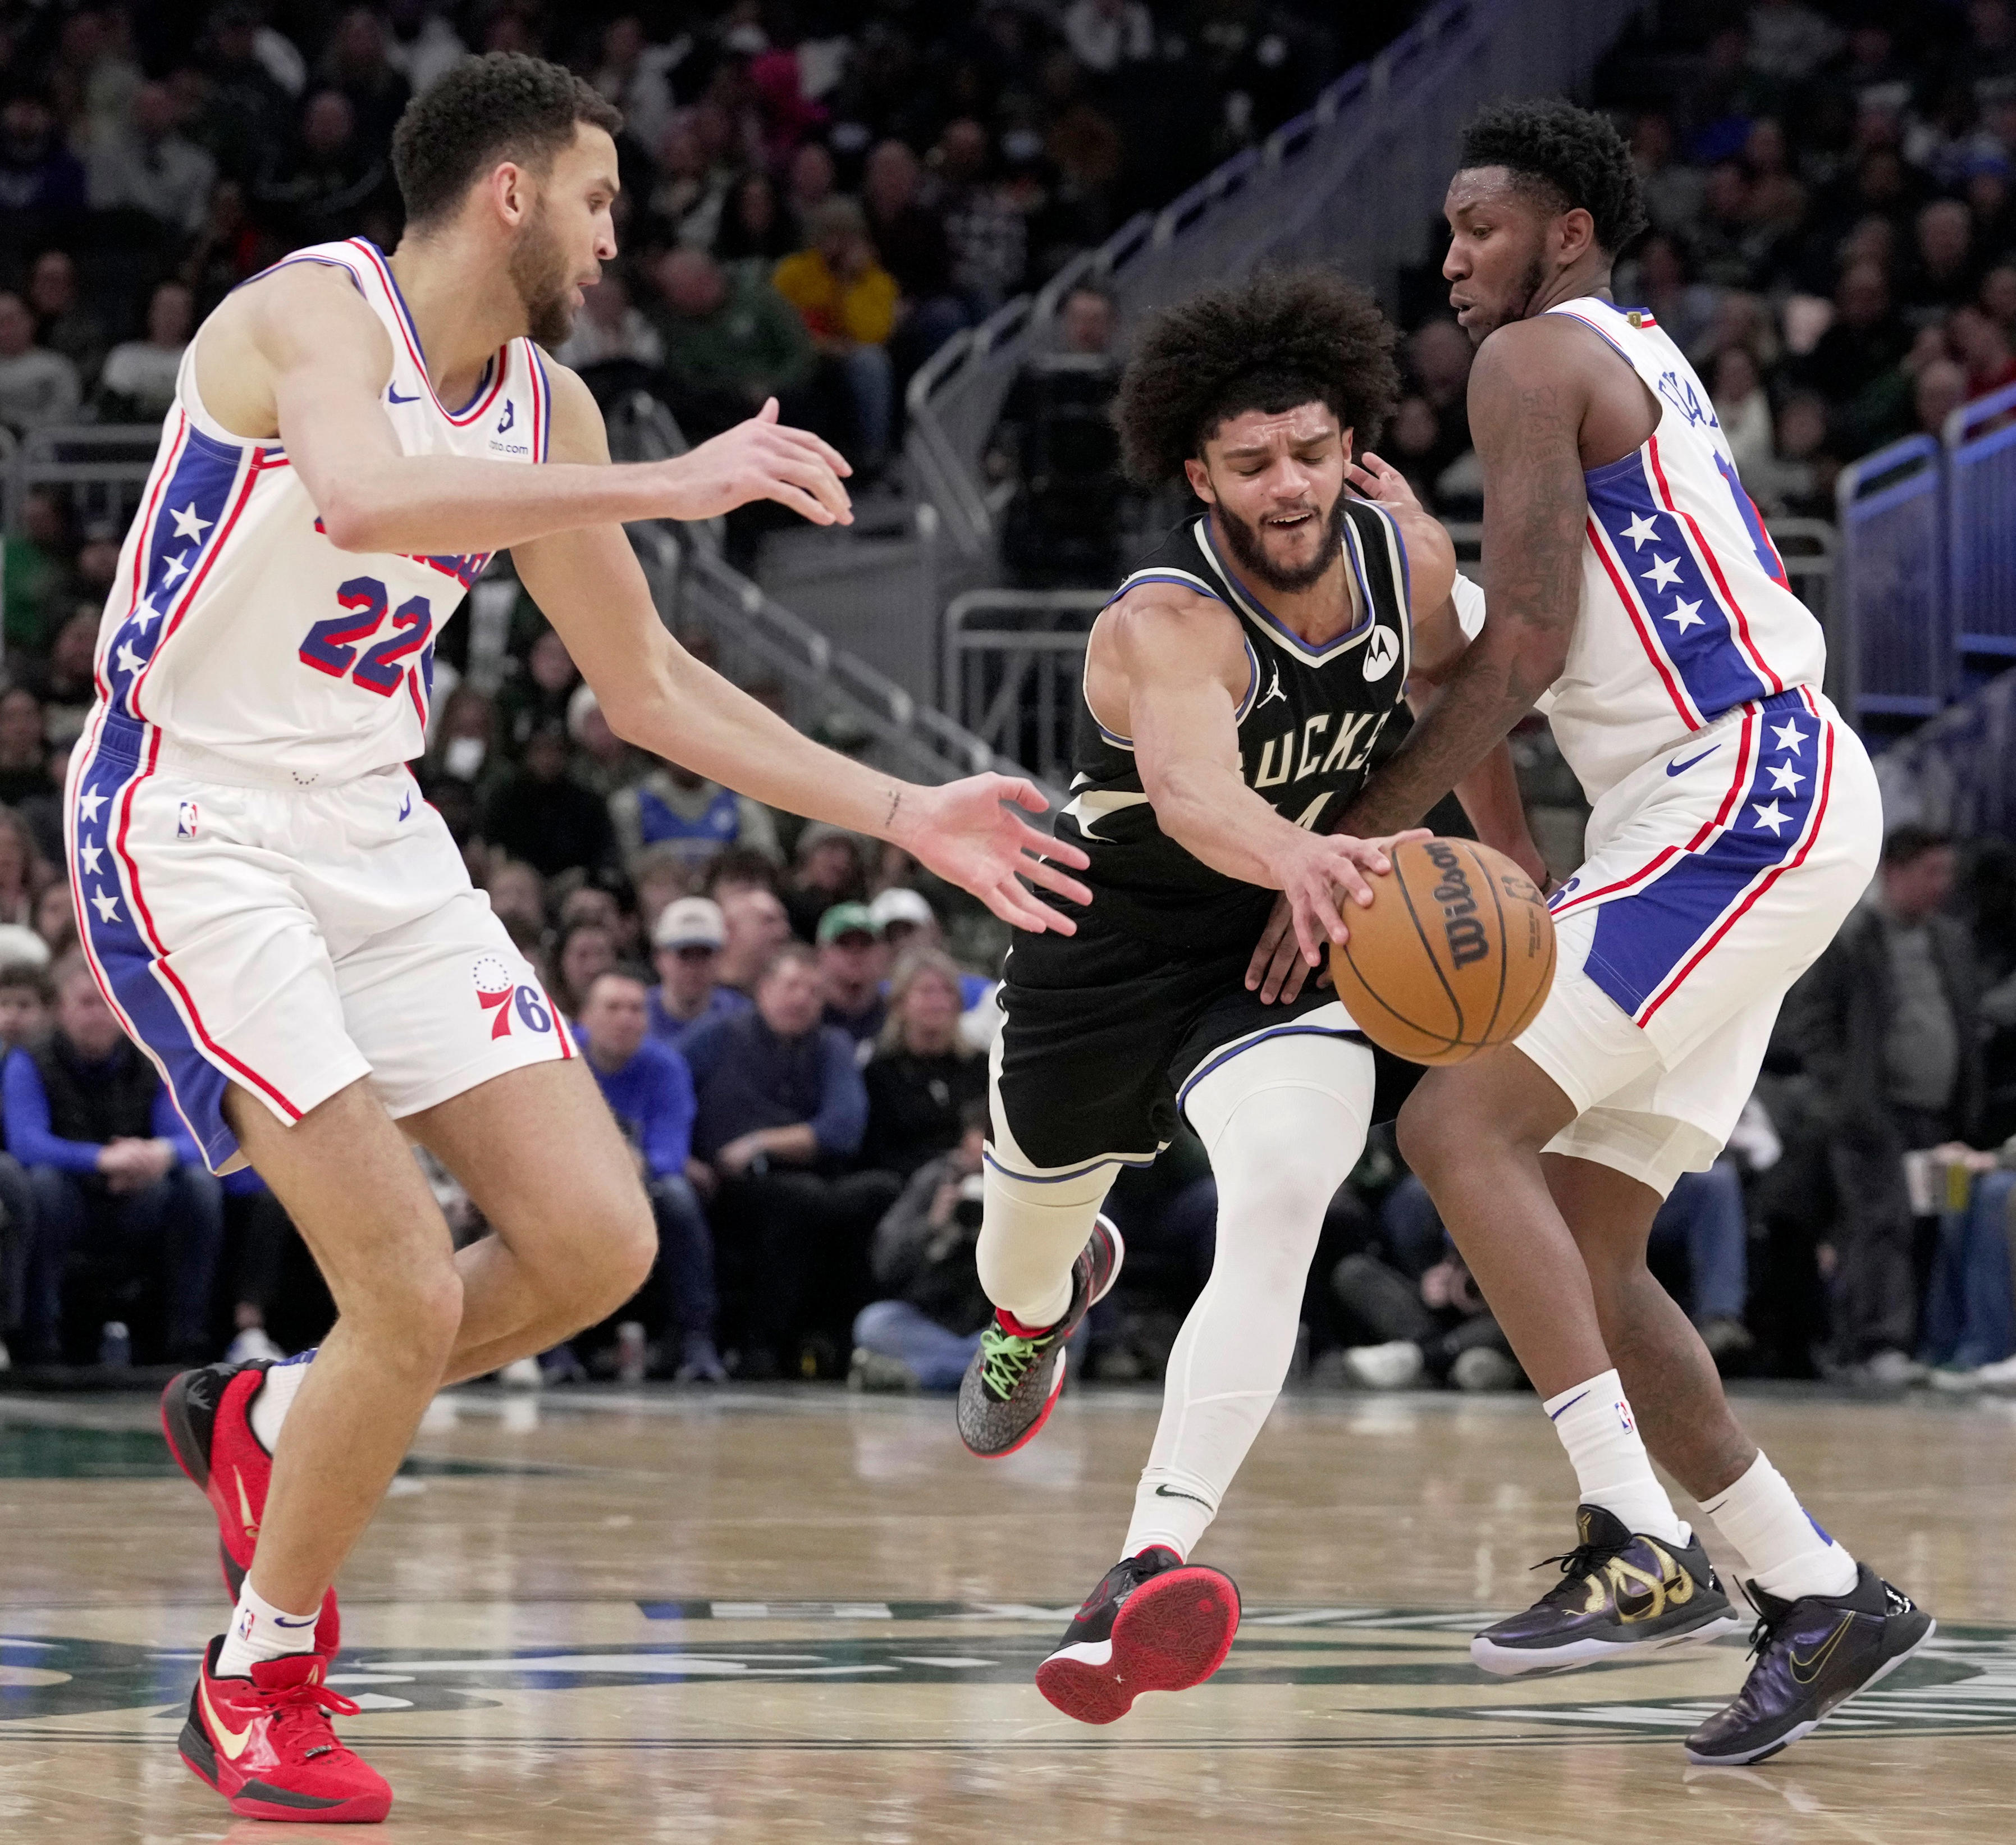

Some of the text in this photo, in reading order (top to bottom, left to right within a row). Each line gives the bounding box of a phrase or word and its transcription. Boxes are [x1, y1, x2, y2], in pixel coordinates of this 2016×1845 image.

[299, 576, 433, 698] 22
[1239, 707, 1393, 789] UCKS
[1421, 842, 1490, 970] Wilson
[476, 984, 551, 1041] 76
